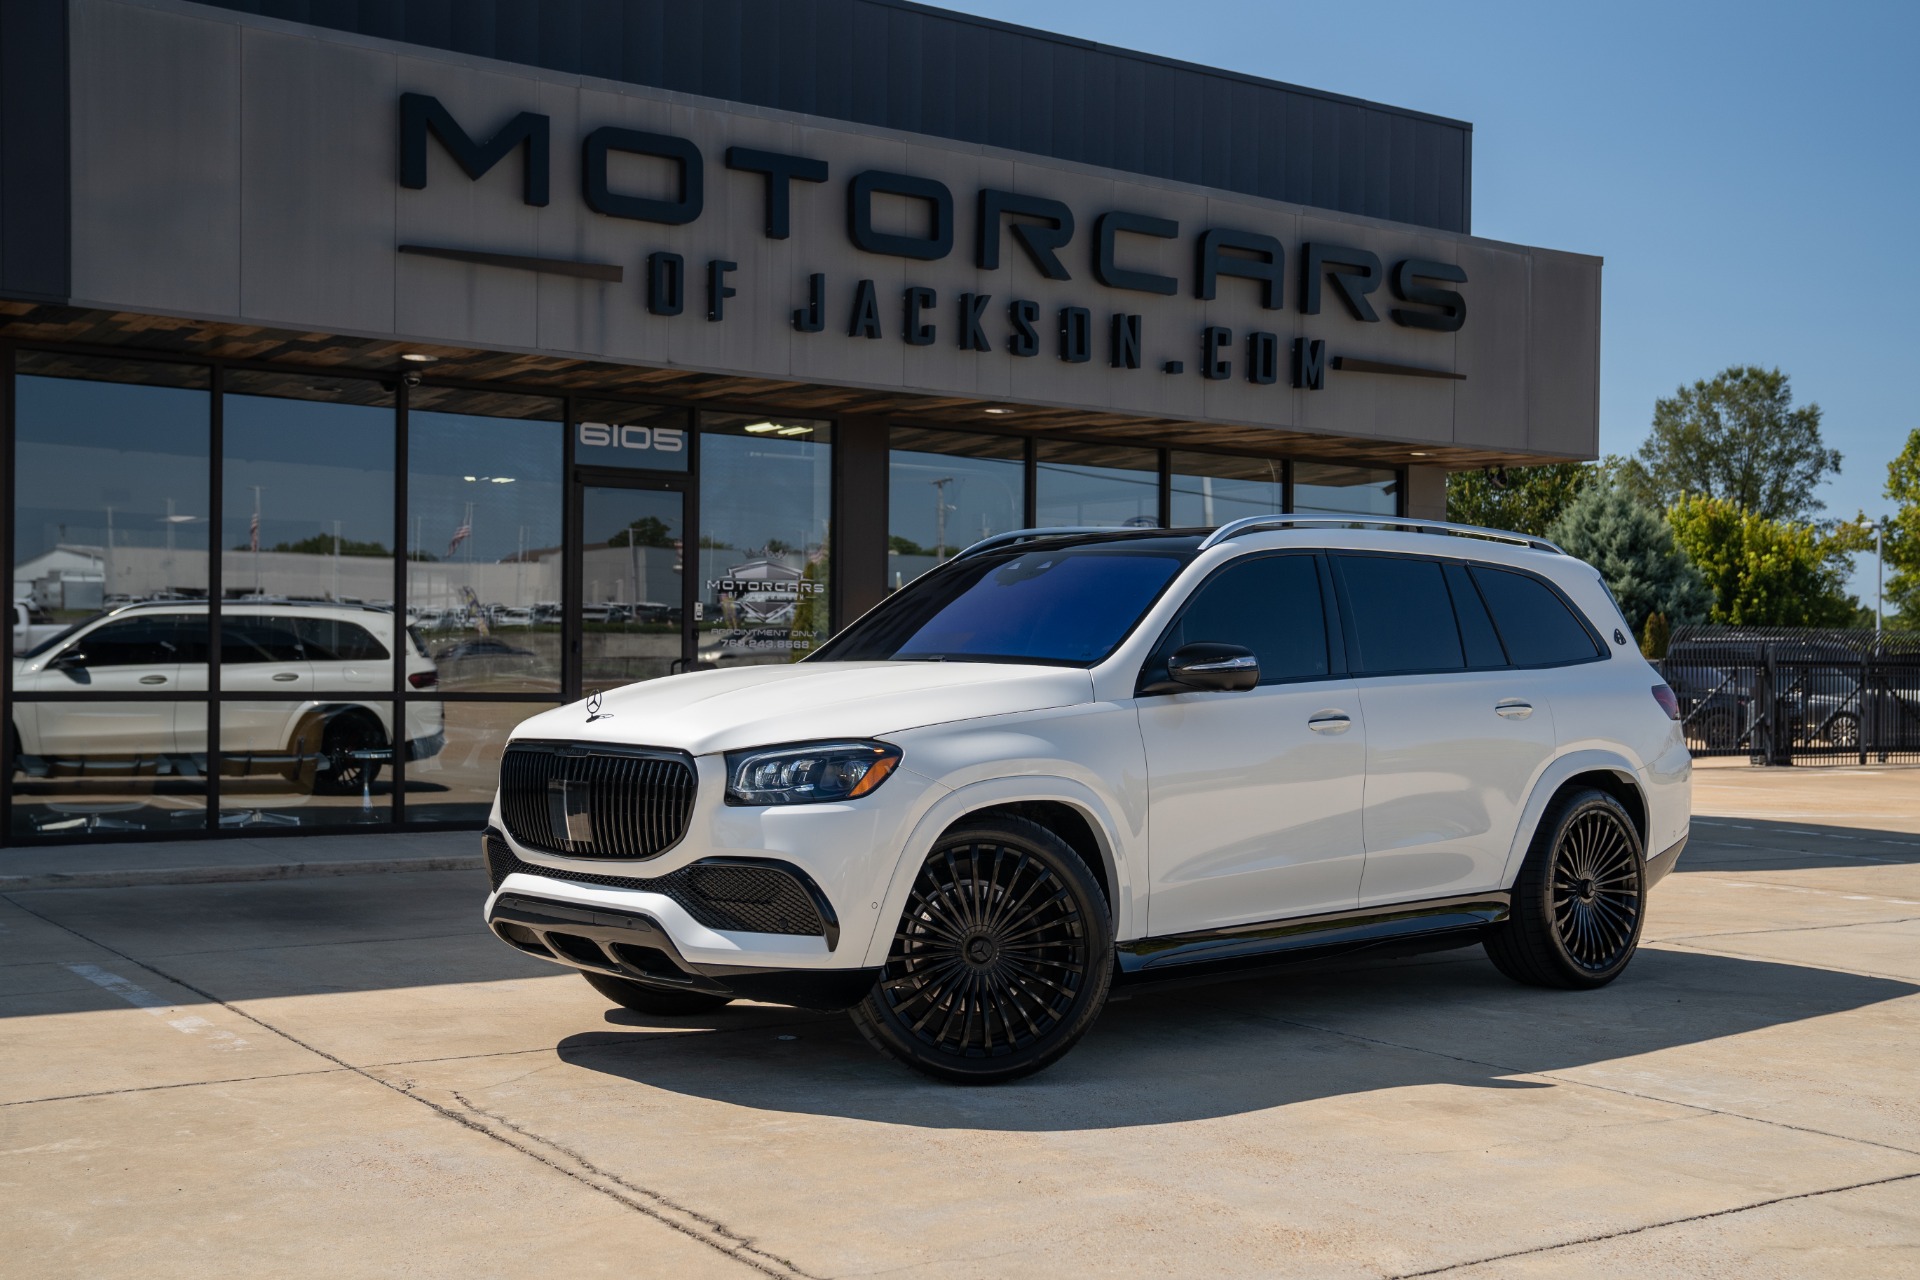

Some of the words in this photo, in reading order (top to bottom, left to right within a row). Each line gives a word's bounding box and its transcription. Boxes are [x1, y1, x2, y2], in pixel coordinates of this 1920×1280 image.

[399, 91, 1468, 332] MOTORCARS
[647, 252, 738, 322] OF
[792, 272, 1326, 391] JACKSON.COM
[579, 422, 683, 452] 6105
[706, 580, 824, 593] MOTORCARS
